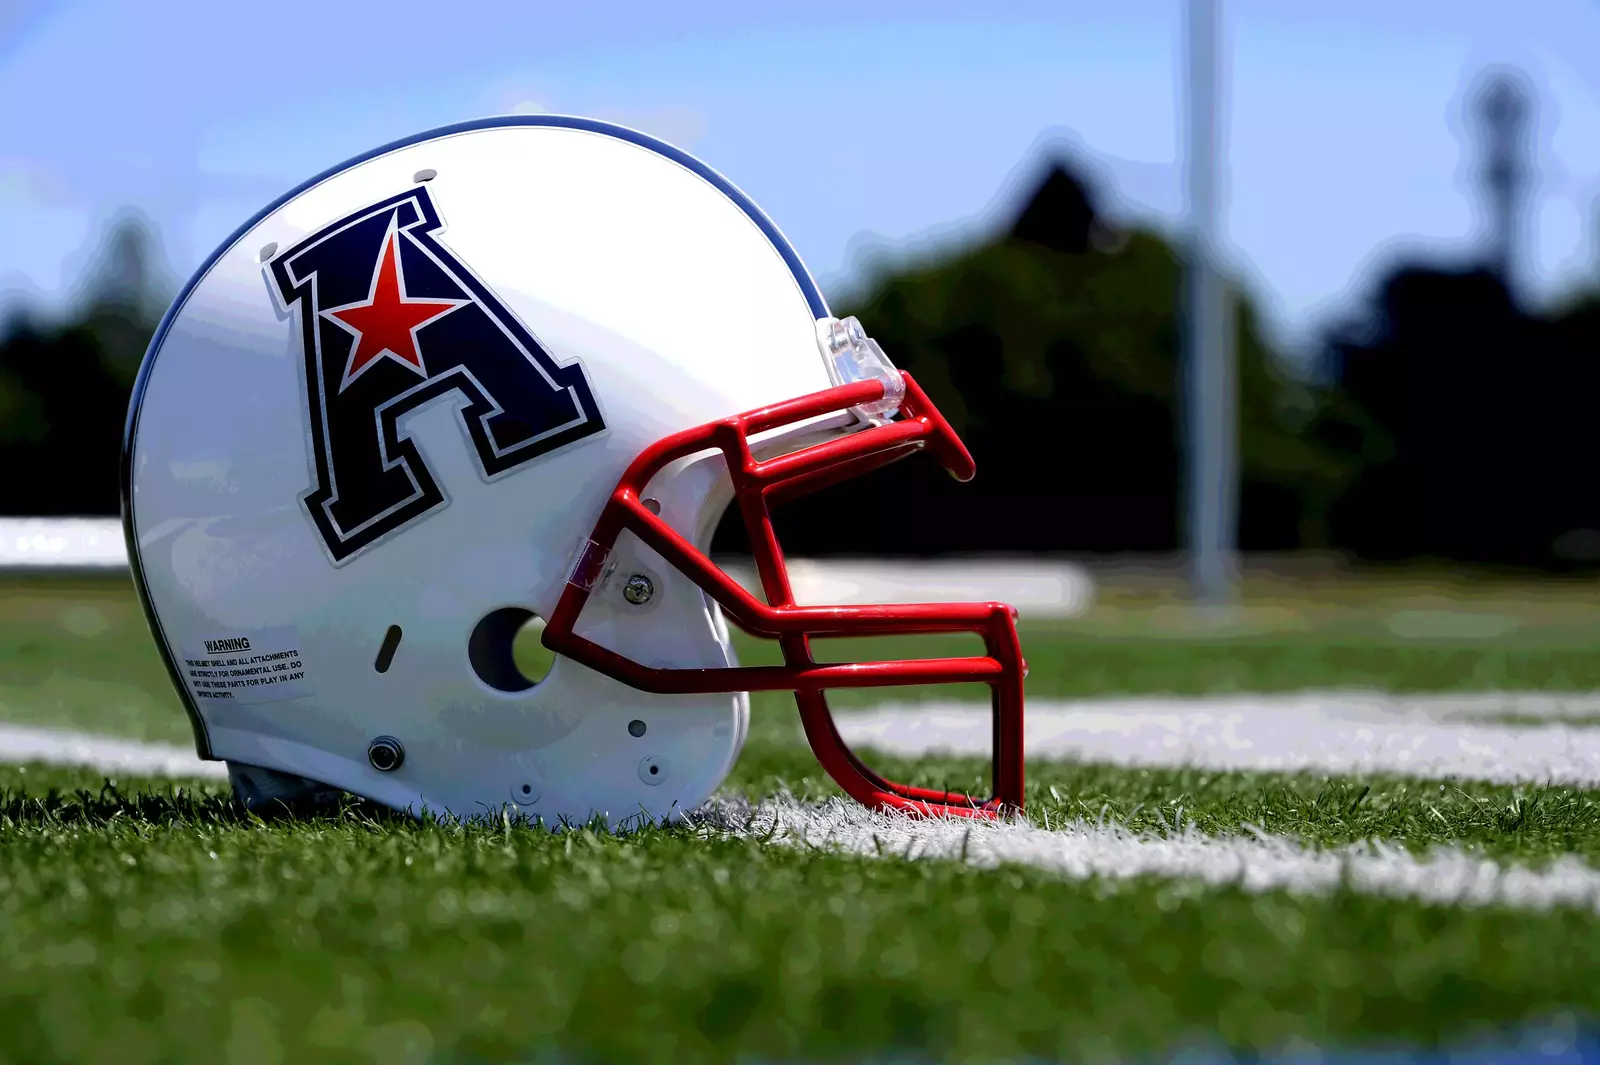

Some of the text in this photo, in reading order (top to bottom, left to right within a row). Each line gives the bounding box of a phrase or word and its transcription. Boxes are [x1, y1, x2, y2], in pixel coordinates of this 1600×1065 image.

[270, 185, 607, 561] A
[204, 637, 250, 652] WARNING
[250, 650, 299, 664] ATTACHMENTS
[198, 670, 218, 678] STRICTLY
[219, 670, 229, 678] FOR
[230, 666, 271, 677] ORNAMENTAL
[272, 663, 289, 672] USE.
[290, 661, 302, 669] DO
[227, 680, 245, 688] PARTS
[260, 676, 278, 685] PLAY
[279, 675, 288, 683] IN
[290, 672, 304, 681] ANY
